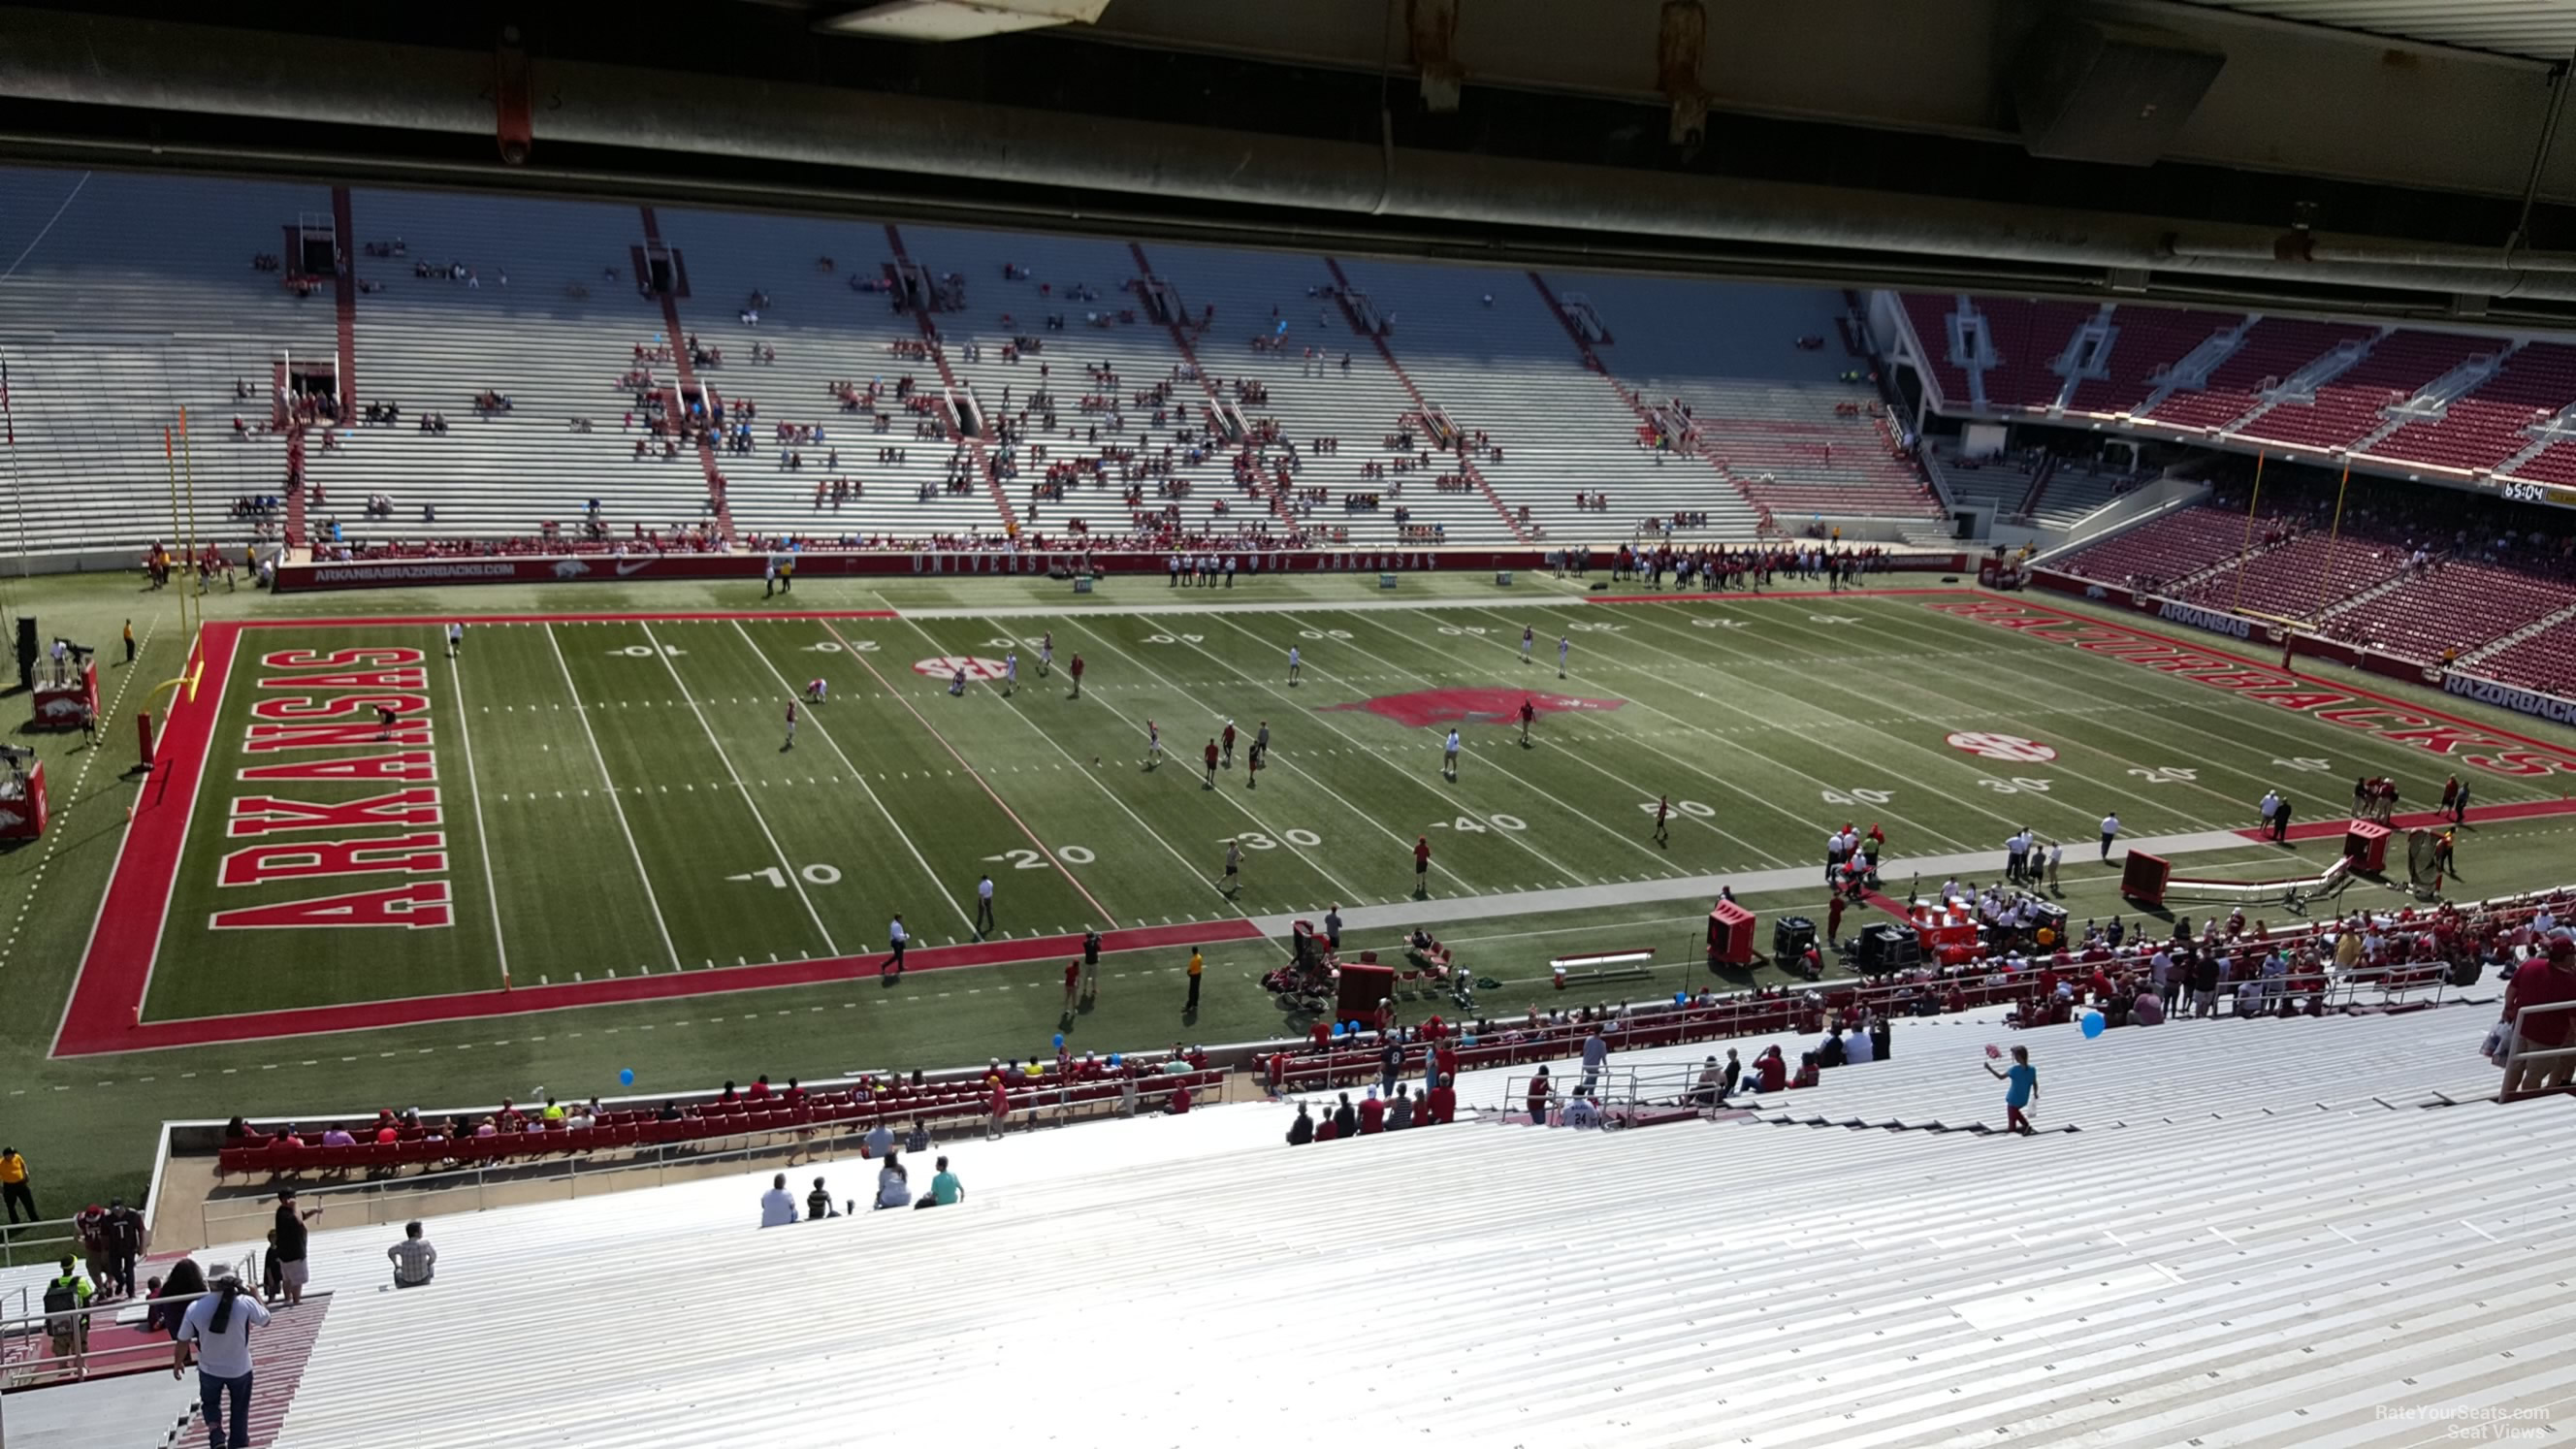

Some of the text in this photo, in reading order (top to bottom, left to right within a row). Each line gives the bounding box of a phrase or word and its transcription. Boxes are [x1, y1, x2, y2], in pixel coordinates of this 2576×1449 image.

[2505, 482, 2543, 500] 65:04
[314, 564, 515, 582] ARKANSASRAZORBACKS.COM
[2157, 602, 2251, 638] ARKANSAS
[208, 646, 455, 931] ARKANSAS
[1978, 777, 2051, 793] 30
[1821, 788, 1889, 806] 40
[1637, 800, 1716, 820] 50
[1448, 814, 1528, 834] 40
[1236, 827, 1323, 851] 30
[1005, 845, 1096, 870] 20
[751, 862, 842, 888] 10
[1391, 1051, 1401, 1064] 8
[1574, 1112, 1587, 1125] 24
